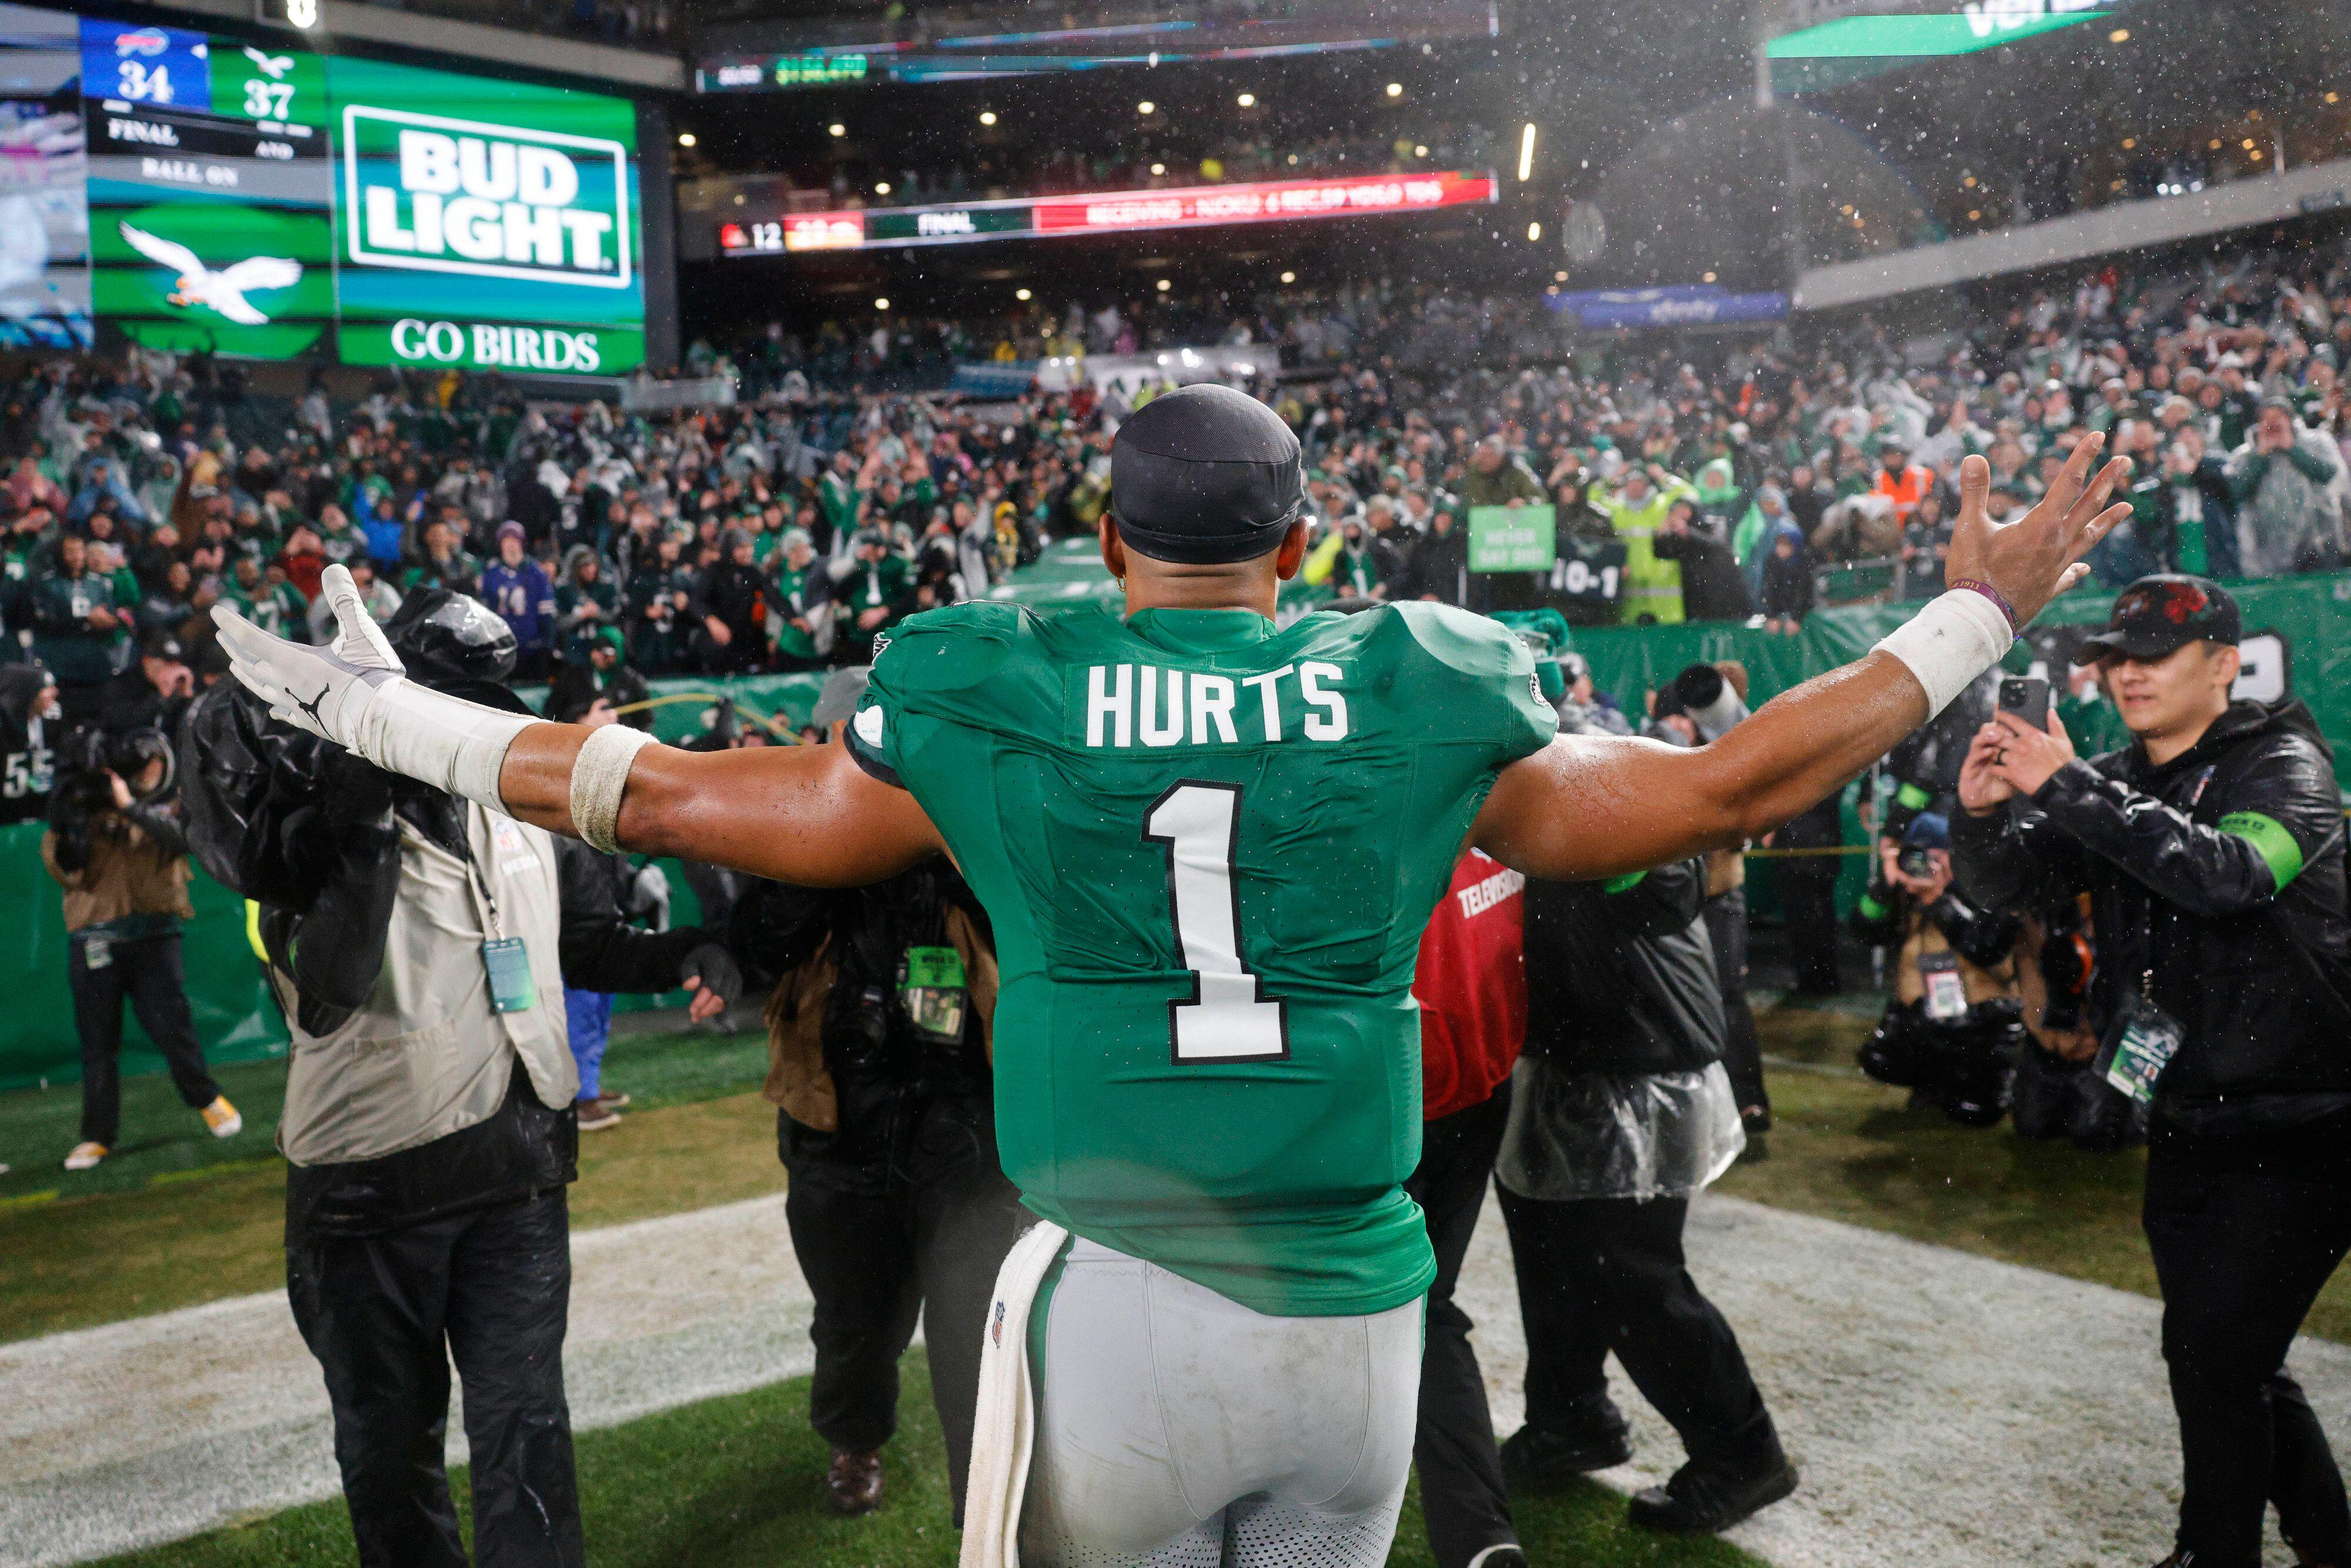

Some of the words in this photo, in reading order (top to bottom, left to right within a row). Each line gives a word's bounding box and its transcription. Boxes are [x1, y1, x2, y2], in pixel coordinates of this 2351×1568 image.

[118, 60, 175, 103] 34
[244, 79, 295, 120] 37
[108, 118, 180, 146] FINAL
[142, 158, 204, 183] BALL
[205, 165, 239, 186] ON
[399, 129, 578, 206] BUD
[366, 185, 612, 270] LIGHT
[752, 222, 782, 250] 12
[390, 318, 465, 361] GO
[472, 323, 600, 371] BIRDS
[1960, 581, 1980, 590] 1911
[1086, 659, 1349, 748] HURTS
[1143, 780, 1287, 1063] 1
